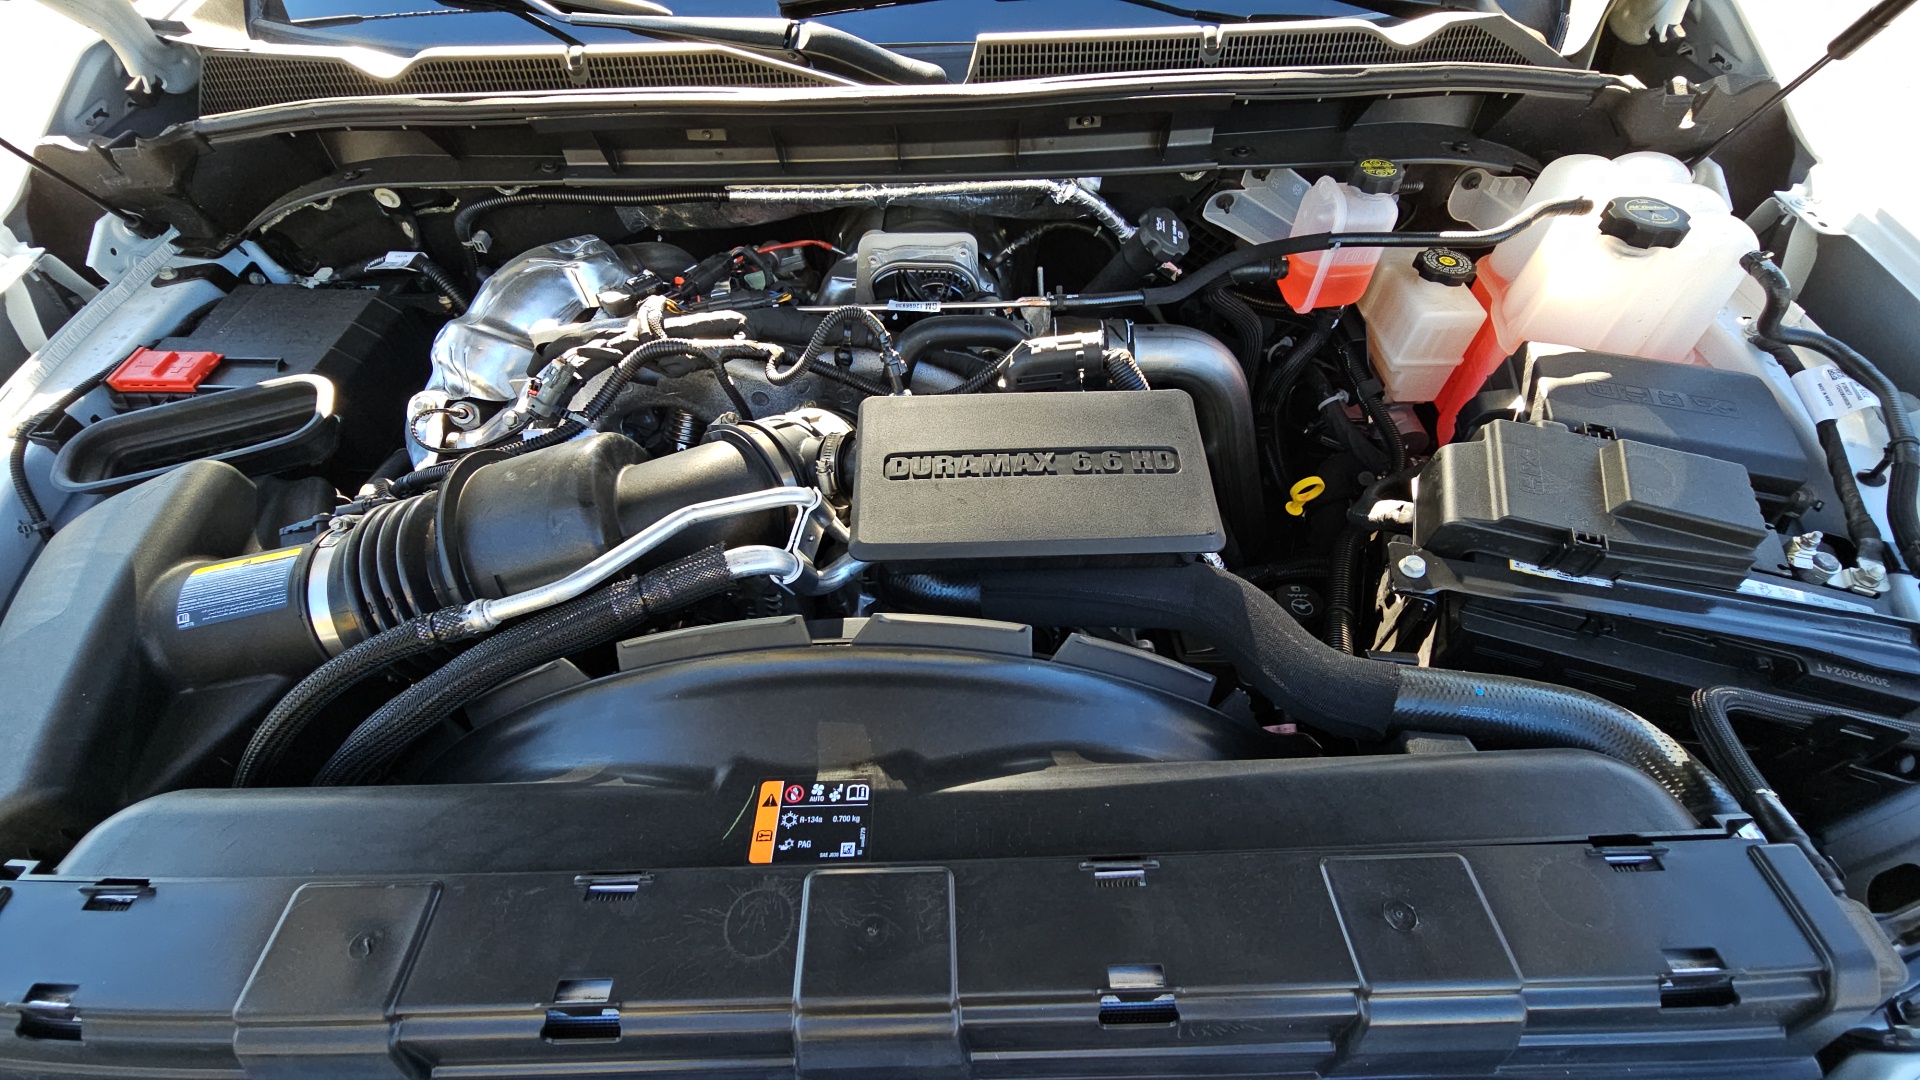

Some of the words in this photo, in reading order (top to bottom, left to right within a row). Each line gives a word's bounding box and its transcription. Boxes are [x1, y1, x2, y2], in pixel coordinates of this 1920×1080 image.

[888, 452, 1056, 479] DURAMAX
[1071, 450, 1123, 474] 6.6
[1131, 449, 1176, 472] HD
[799, 815, 823, 823] R-134a
[832, 815, 851, 823] 0.700
[852, 815, 860, 823] kg
[797, 840, 811, 848] PAG
